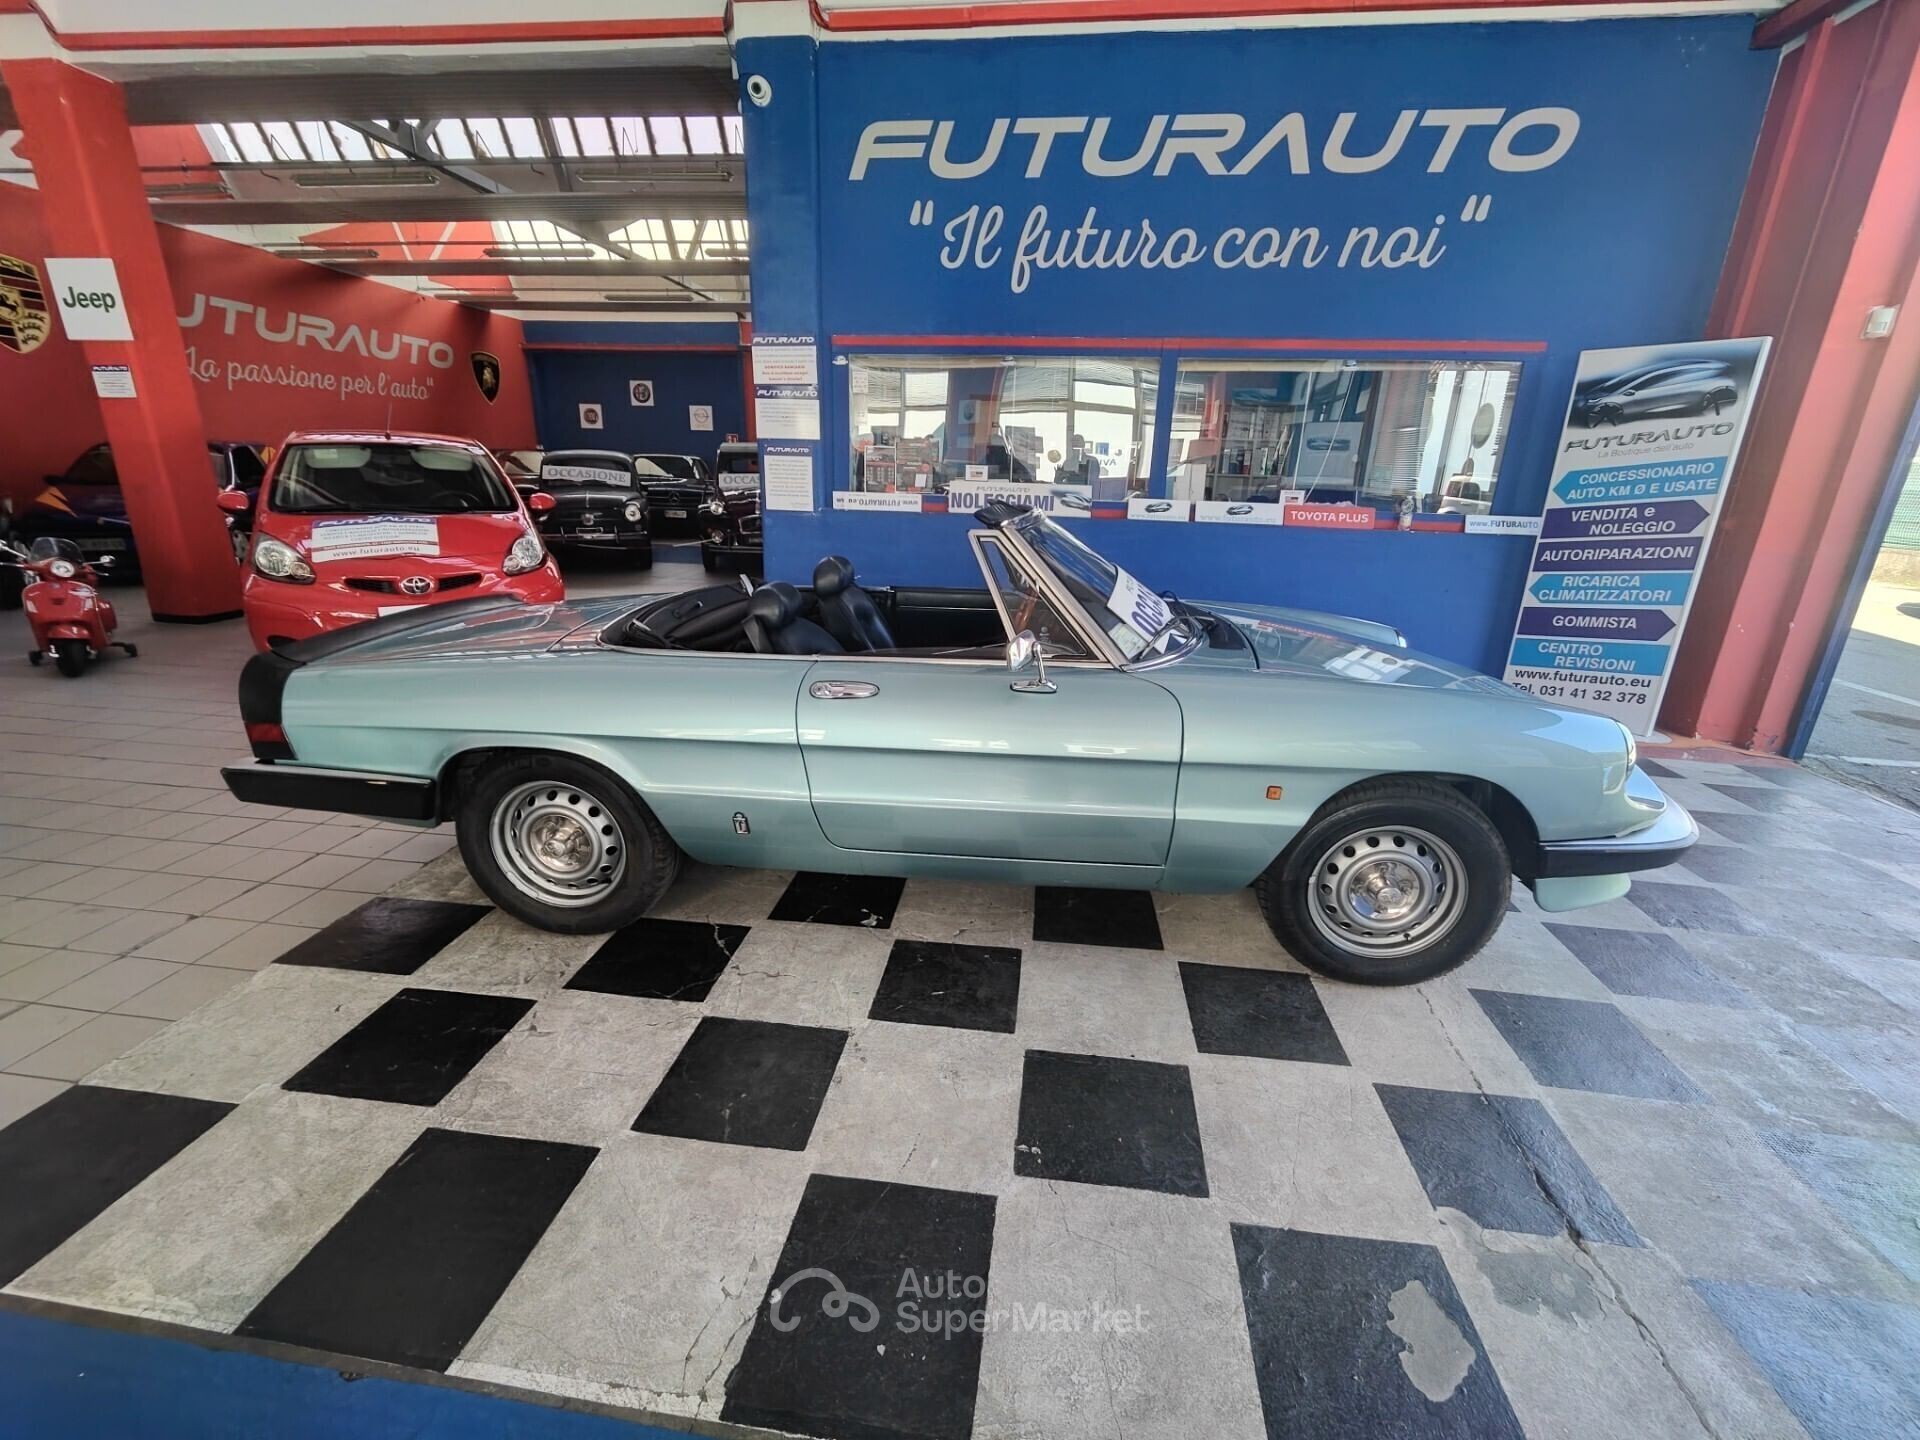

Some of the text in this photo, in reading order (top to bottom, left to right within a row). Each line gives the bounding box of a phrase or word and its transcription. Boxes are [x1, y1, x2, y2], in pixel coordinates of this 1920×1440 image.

[848, 106, 1581, 181] FUTURAUTO
[1011, 206, 1203, 294] futuro
[1213, 226, 1328, 269] con
[62, 286, 116, 313] Jeep
[176, 293, 455, 369] UTURAUTO
[753, 336, 816, 345] FUTURAUTO
[227, 360, 337, 390] passione
[341, 376, 375, 400] per
[757, 388, 818, 398] FUTURAUTO
[1564, 421, 1735, 453] FUTURAUTO
[766, 446, 810, 454] FUTURAUTO
[1611, 445, 1651, 458] Boutique
[547, 467, 627, 484] OCCASIONE
[723, 475, 760, 485] OCCA
[1578, 462, 1715, 486] CONCESSIONARIO
[1566, 487, 1605, 501] AUTO
[1609, 485, 1630, 498] KM
[1650, 482, 1660, 495] E
[1664, 479, 1718, 493] USATE
[318, 516, 431, 526] FUTURAUTO
[1290, 510, 1369, 523] TOYOTA PLUS
[1571, 505, 1656, 522] VENDITA e
[1589, 520, 1676, 536] NOLEGGIO
[1540, 546, 1694, 562] AUTORIPARAZIONI
[1562, 575, 1641, 588] RICARICA
[1538, 589, 1672, 602] CLIMATIZZATORI
[1552, 615, 1637, 630] GOMMISTA
[1537, 641, 1604, 656] CENTRO
[1554, 655, 1636, 672] REVISIONI
[1514, 668, 1652, 688] www.futurauto.eu
[1539, 684, 1566, 699] 031
[1569, 688, 1587, 701] 41
[1592, 690, 1612, 702] 32
[1616, 691, 1647, 705] 378
